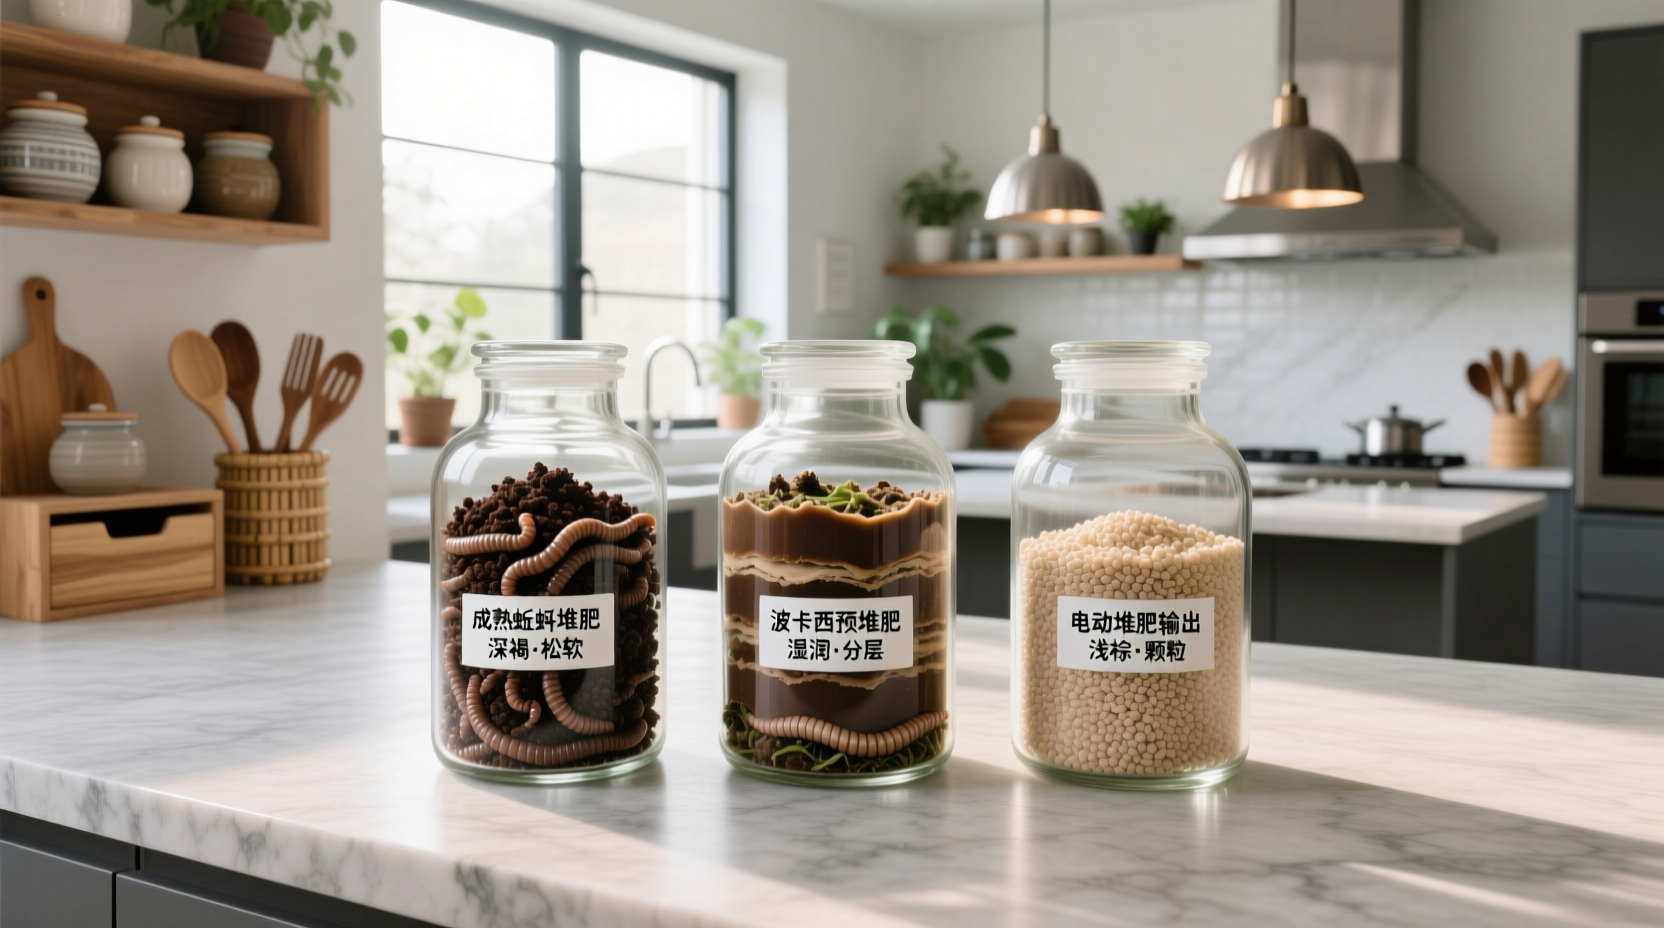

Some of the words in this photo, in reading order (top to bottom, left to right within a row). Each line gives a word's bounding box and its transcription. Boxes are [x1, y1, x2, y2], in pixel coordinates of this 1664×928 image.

[770, 609, 901, 633] 波卡西预堆肥
[1071, 610, 1201, 635] 电动堆肥输出
[488, 637, 584, 661] 深褐·松软
[787, 638, 885, 661] 湿润·分层
